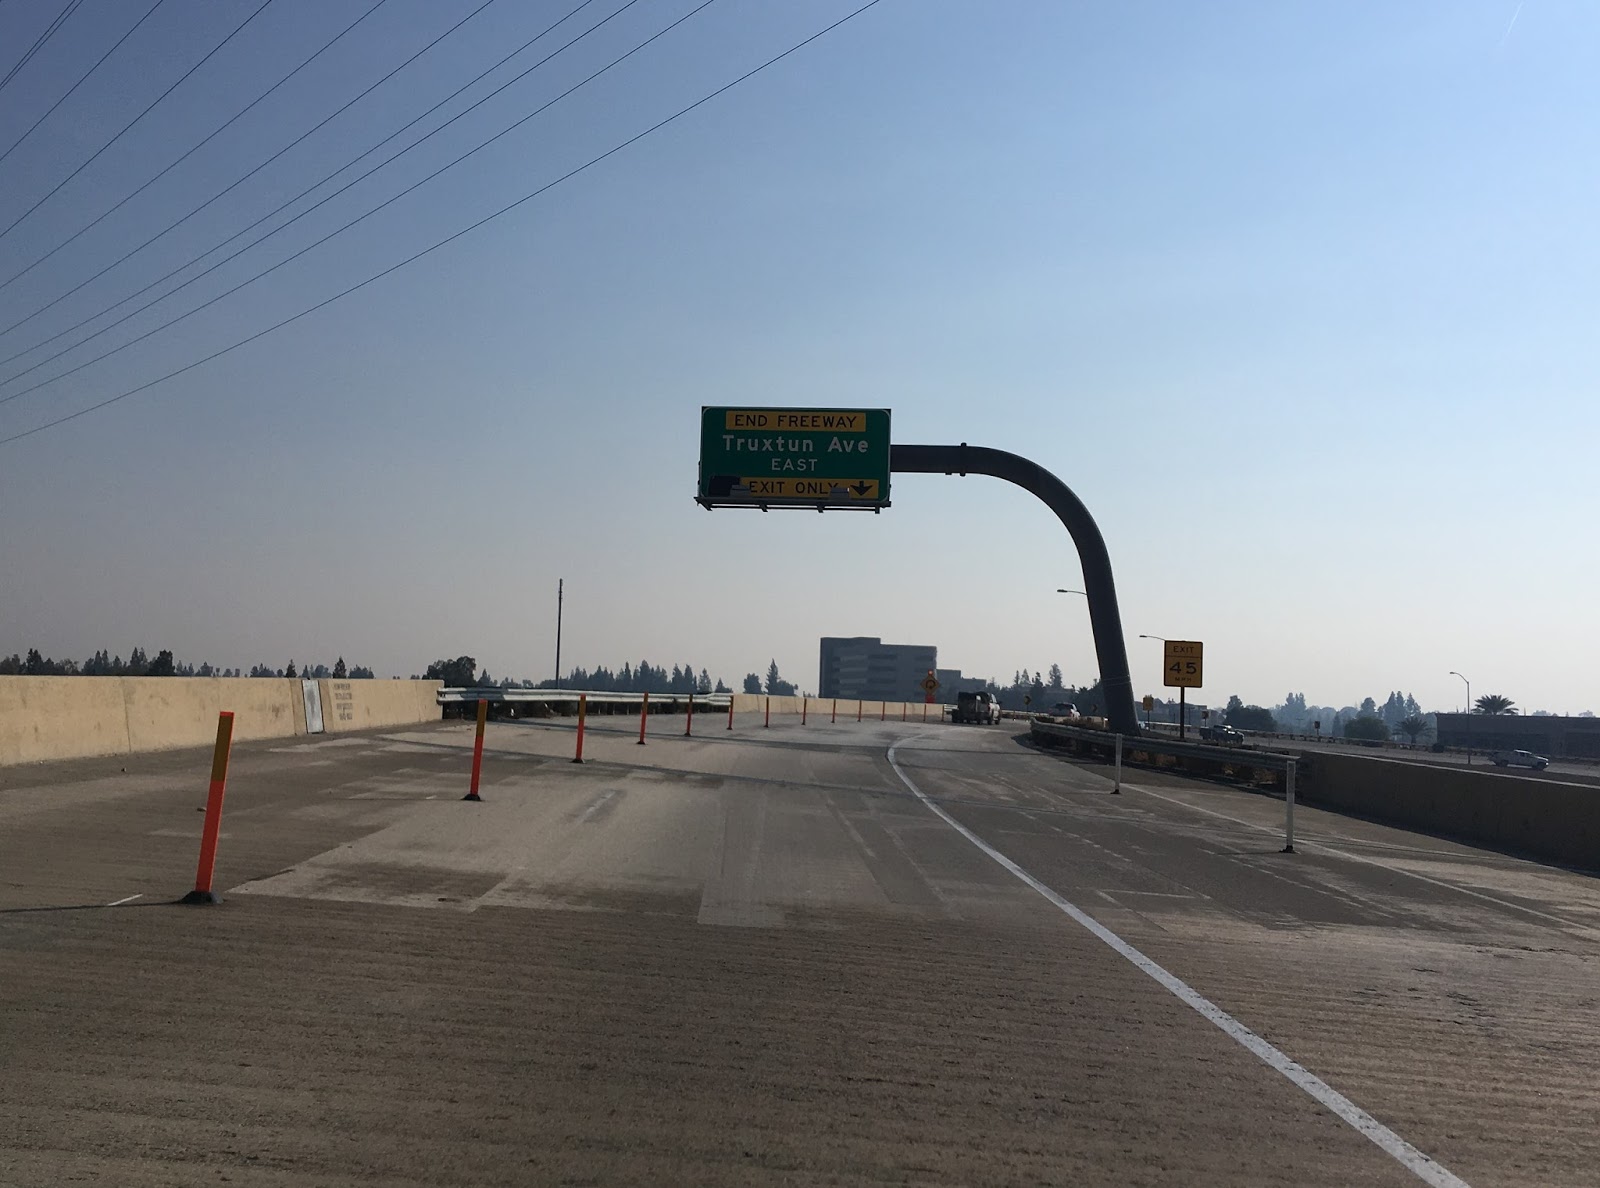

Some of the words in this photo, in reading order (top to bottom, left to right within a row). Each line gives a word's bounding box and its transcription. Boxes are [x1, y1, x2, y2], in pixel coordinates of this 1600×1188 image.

[734, 414, 768, 427] END
[777, 415, 857, 428] FREEWAY
[722, 434, 814, 452] Truxtun
[827, 436, 869, 453] Ave
[771, 458, 818, 472] EAST
[749, 481, 785, 494] EXIT
[1170, 662, 1197, 674] 45
